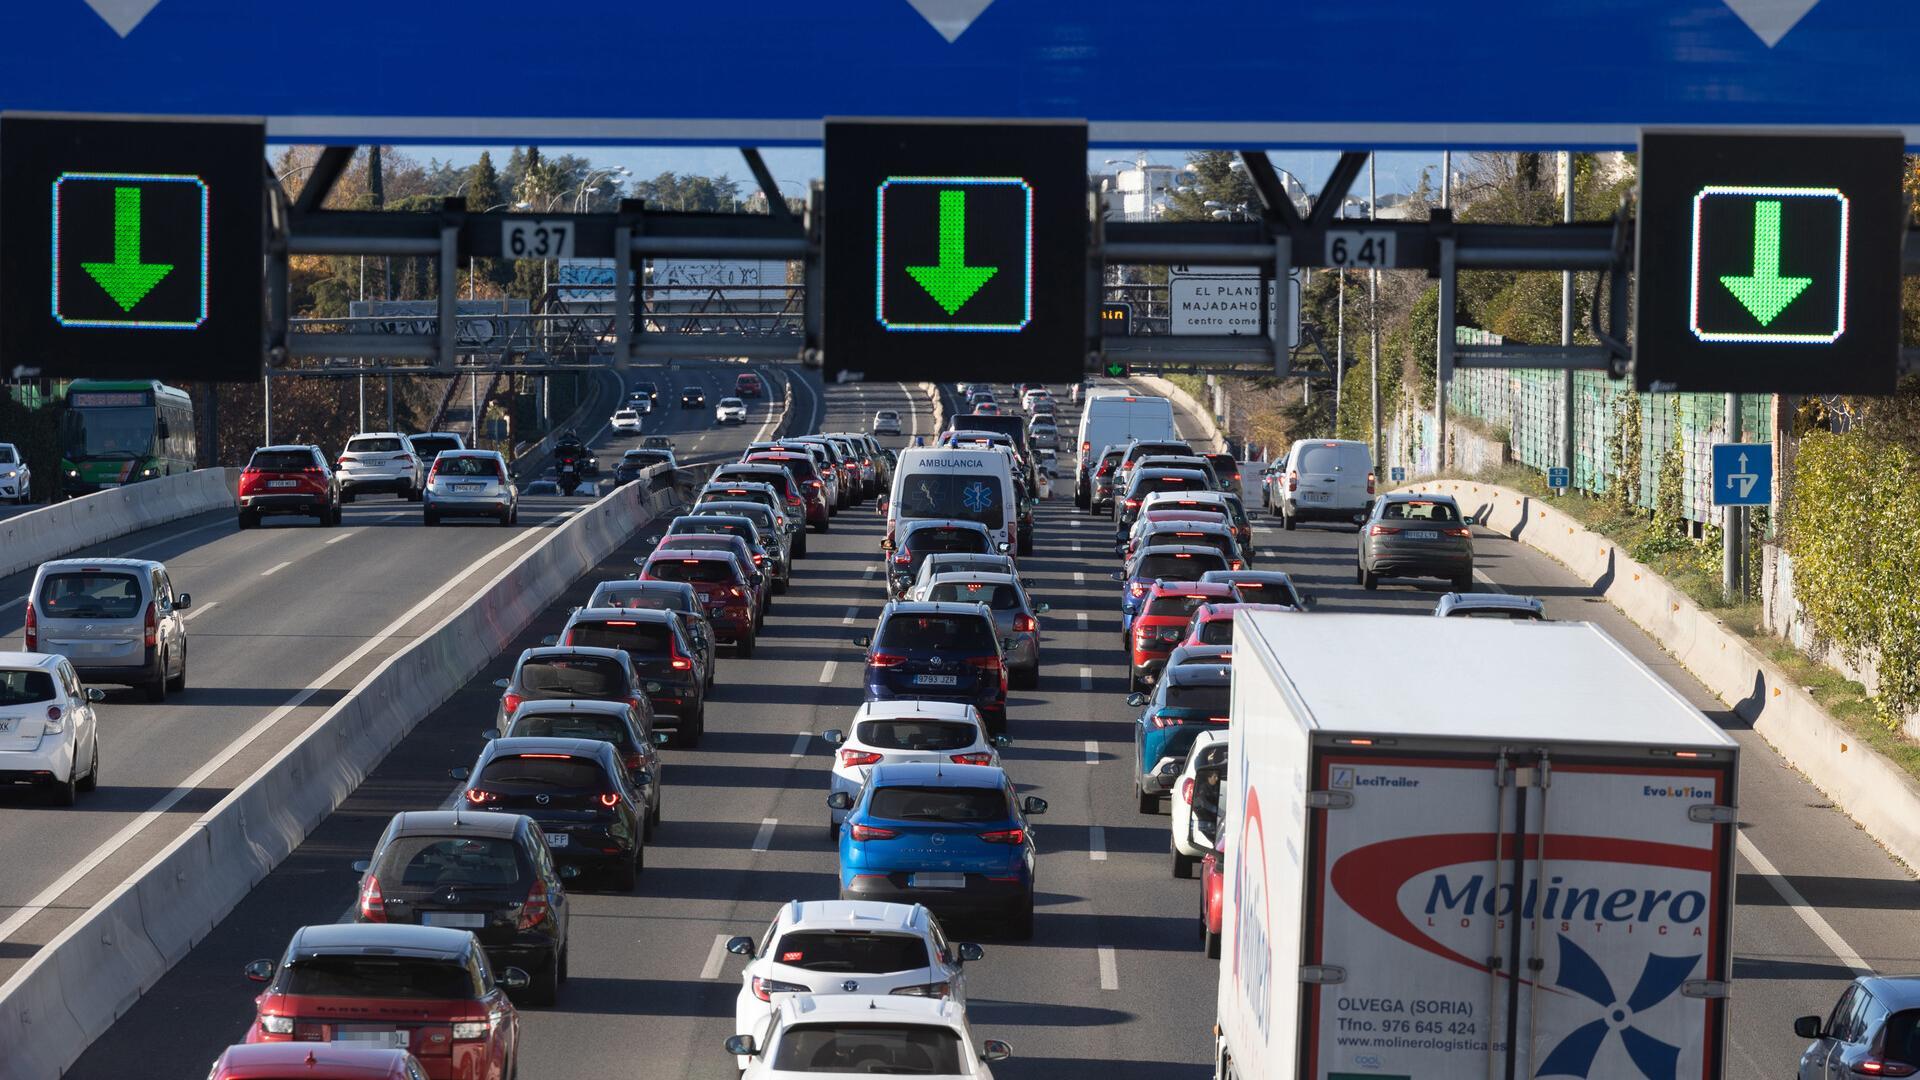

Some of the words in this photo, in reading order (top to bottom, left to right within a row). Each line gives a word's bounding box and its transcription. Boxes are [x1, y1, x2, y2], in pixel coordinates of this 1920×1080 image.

[1195, 287, 1211, 296] EL
[1217, 286, 1275, 296] PLANTO
[1182, 302, 1277, 311] MAJADAHOD
[1187, 317, 1223, 325] centro
[919, 459, 983, 468] AMBULANCIA
[1356, 775, 1420, 788] LeciTrailer
[1643, 785, 1712, 799] EvoLuTion
[1424, 873, 1706, 924] Molinero
[1427, 918, 1703, 937] LOGISTICA
[1337, 997, 1405, 1013] OLVEGA
[1410, 1000, 1473, 1017] (SORIA)
[1337, 1018, 1377, 1032] Tfno.
[1382, 1020, 1410, 1033] 976
[1415, 1021, 1443, 1034] 645
[1448, 1022, 1476, 1035] 424
[1337, 1037, 1508, 1053] www.molinerologisticaes
